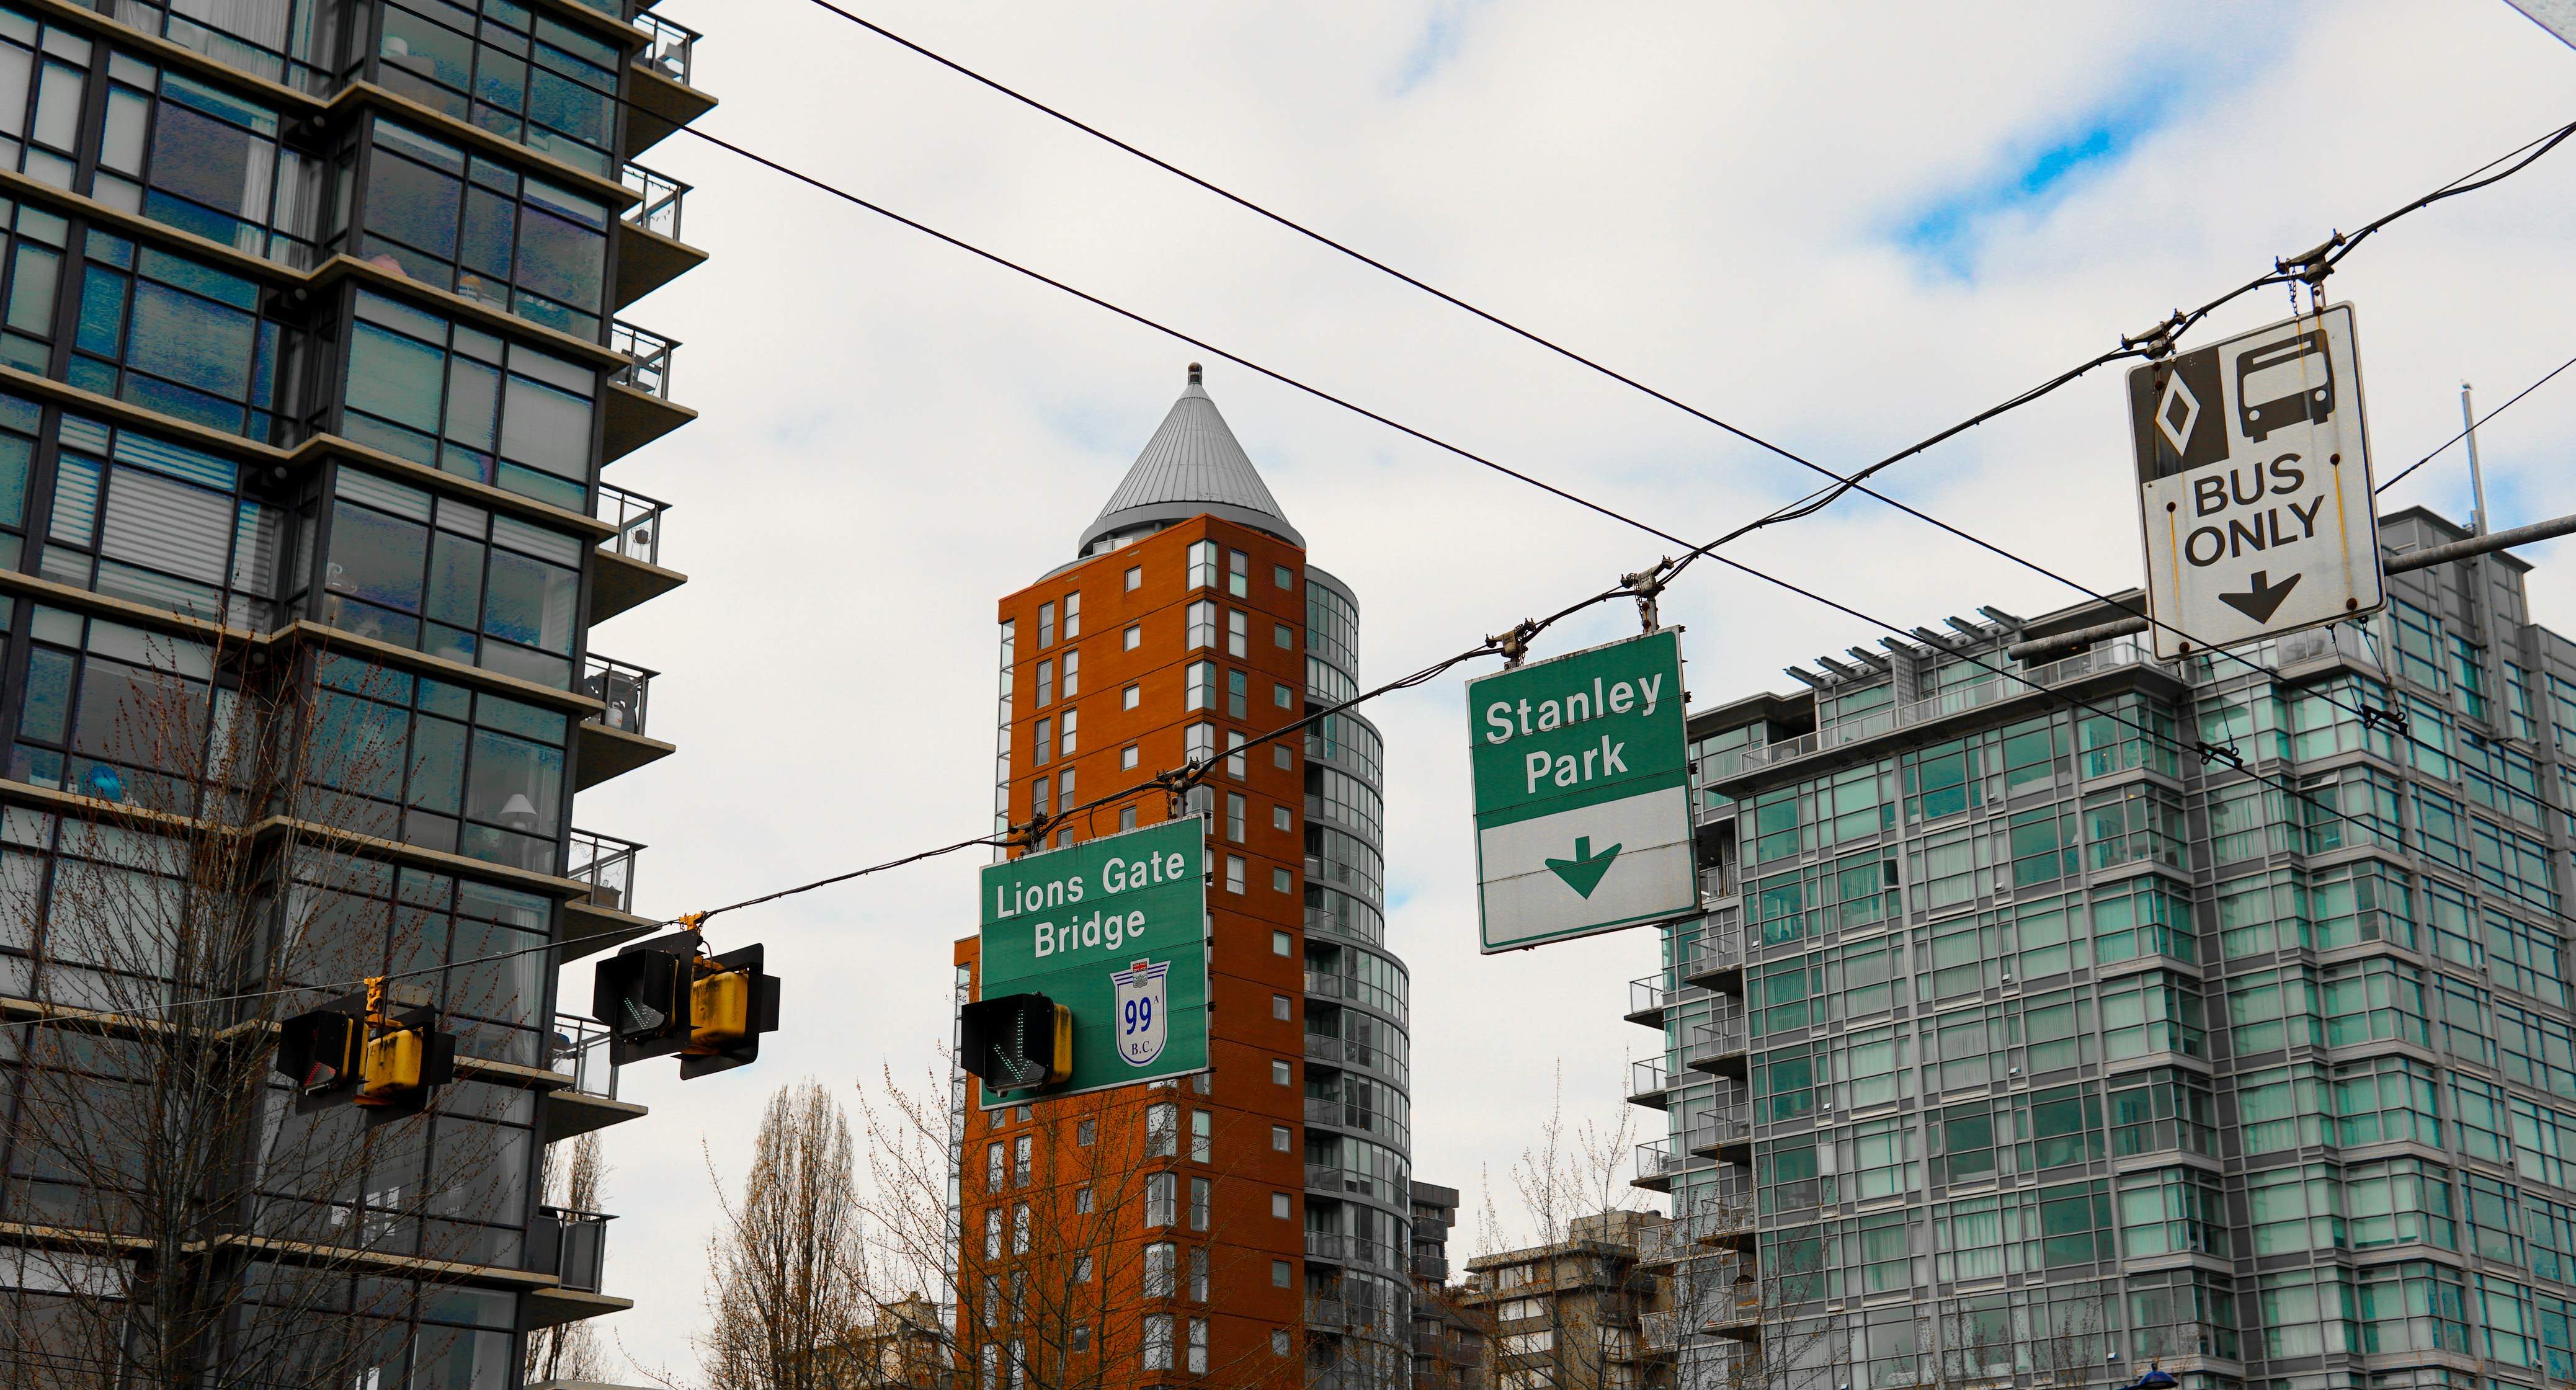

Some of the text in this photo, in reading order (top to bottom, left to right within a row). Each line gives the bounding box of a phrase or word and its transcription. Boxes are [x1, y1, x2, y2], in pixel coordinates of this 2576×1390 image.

[2194, 453, 2304, 517] BUS
[2185, 495, 2325, 567] ONLY
[1486, 673, 1662, 744] Stanley
[1526, 735, 1628, 794] Park
[997, 850, 1185, 919] Lions Gate
[1035, 911, 1145, 958] Bridge
[1125, 997, 1152, 1035] 99
[1131, 1040, 1153, 1056] B.C.
